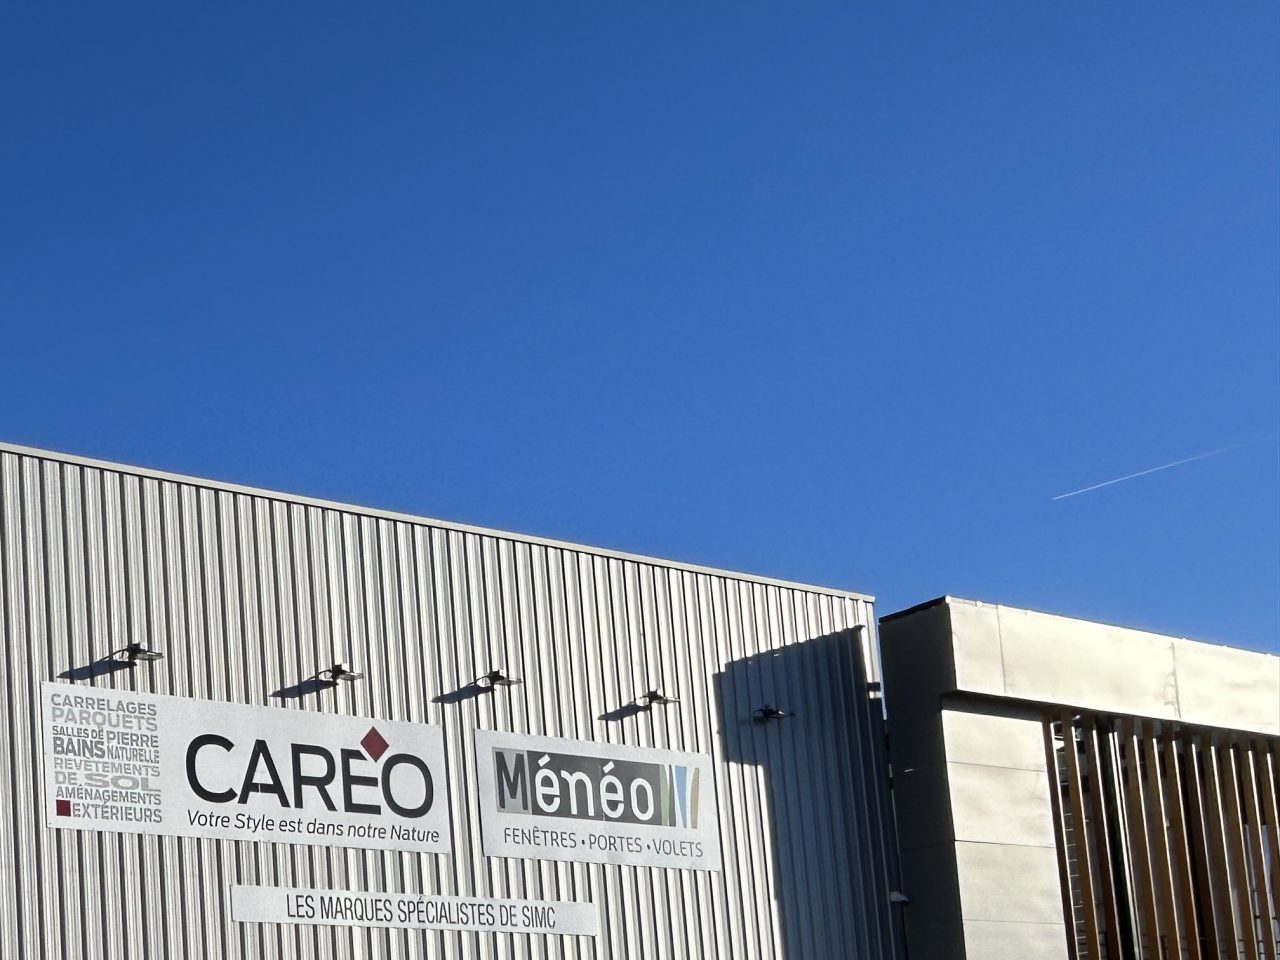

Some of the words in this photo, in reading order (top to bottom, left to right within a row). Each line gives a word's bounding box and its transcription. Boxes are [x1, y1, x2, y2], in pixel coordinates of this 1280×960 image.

[51, 693, 157, 716] CARRELAGES
[51, 707, 158, 731] PARQUETS
[52, 725, 90, 739] SALLES
[91, 729, 104, 740] DE
[106, 730, 159, 748] PIERRE
[53, 736, 105, 759] BAINS
[55, 770, 78, 786] DE
[84, 772, 162, 793] SOL
[495, 752, 655, 822] Ménéo
[56, 784, 162, 806] AMÉNAGEMENTS
[72, 801, 163, 824] EXTÉRIEURS
[187, 809, 231, 829] Votre
[235, 812, 275, 834] Style
[278, 818, 303, 834] est
[306, 818, 344, 837] dans
[347, 823, 387, 839] notre
[390, 824, 440, 843] Nature
[503, 825, 577, 849] FENÊTRES
[588, 833, 643, 853] PORTES
[652, 838, 704, 858] VOLETS
[286, 894, 315, 920] LES
[320, 895, 394, 923] MARQUES
[397, 895, 496, 927] SPÉCIALISTES
[499, 904, 518, 928] DE
[521, 905, 556, 930] SIMC
